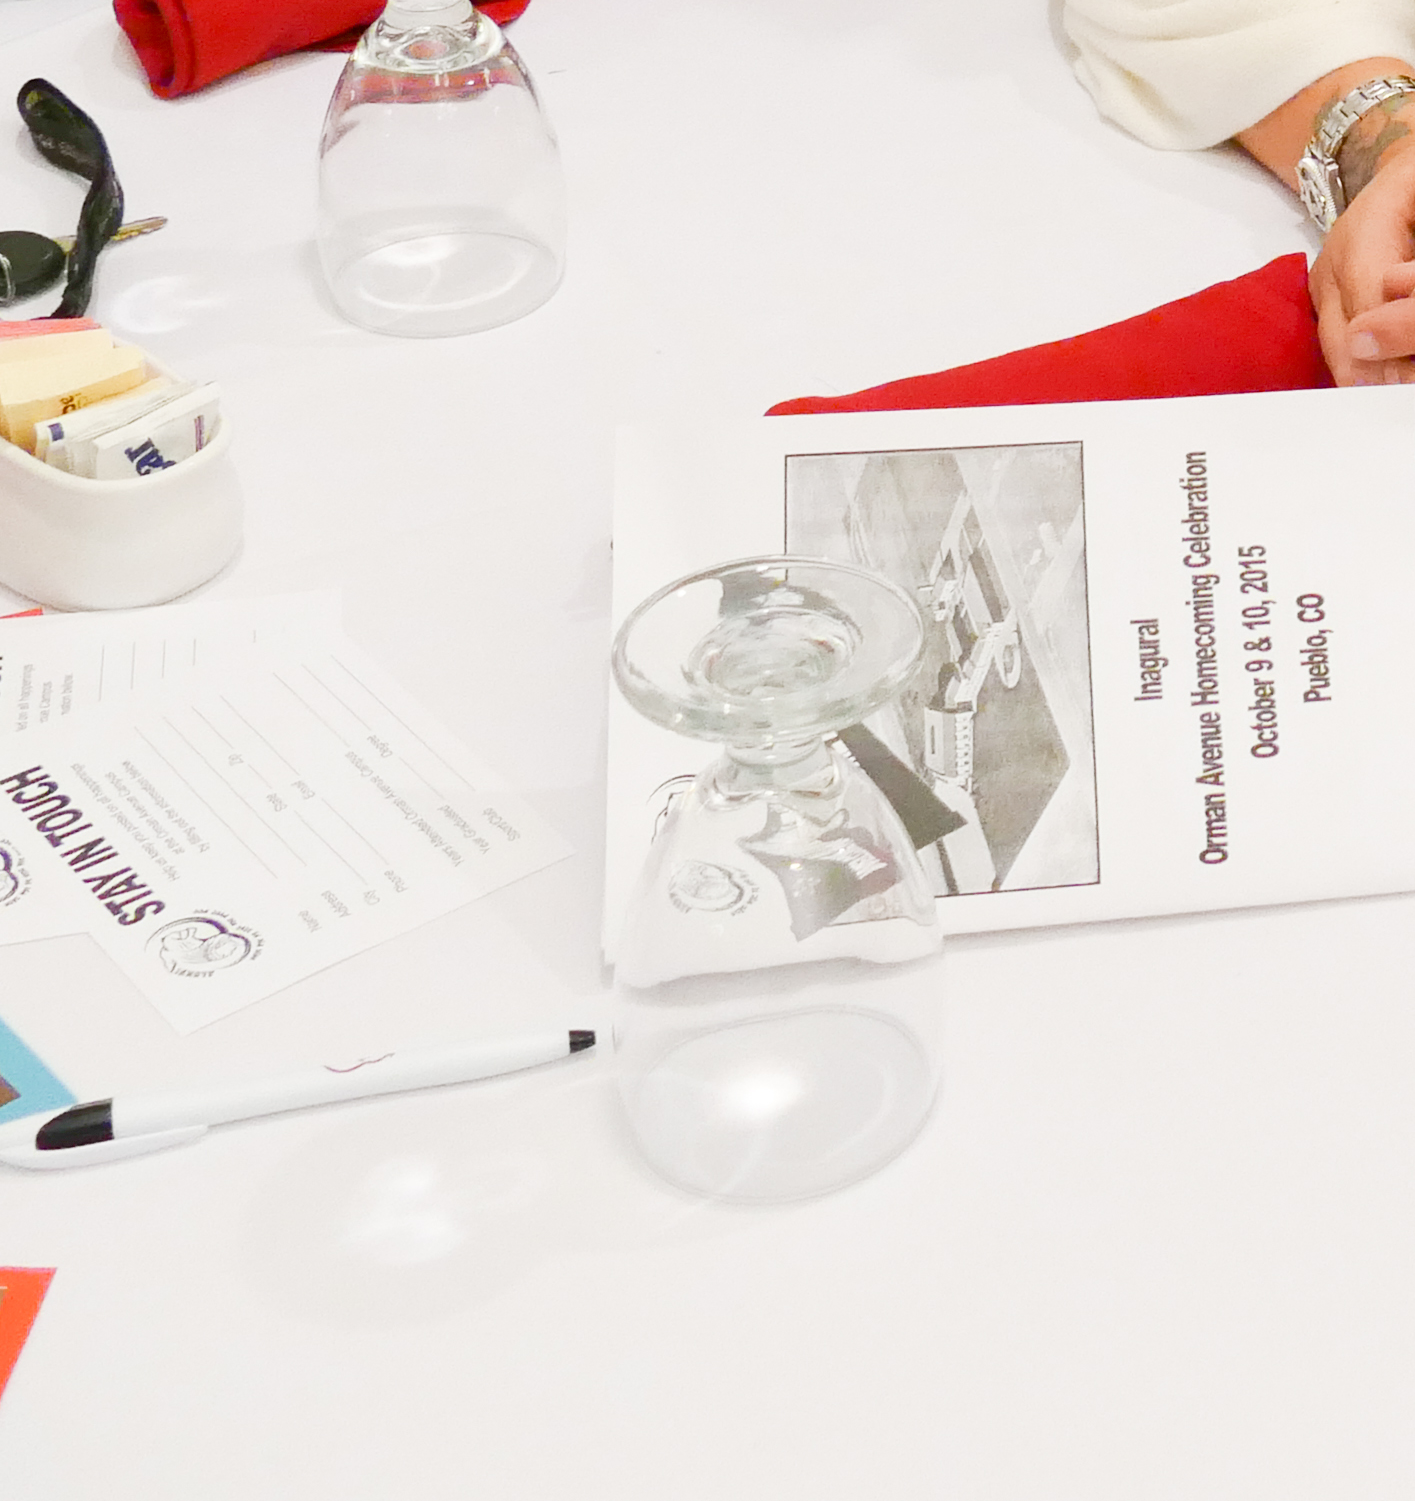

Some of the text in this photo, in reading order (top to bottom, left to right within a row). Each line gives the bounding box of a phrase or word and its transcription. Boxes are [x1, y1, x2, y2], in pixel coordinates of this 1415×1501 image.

[1130, 617, 1169, 702] Inagural
[1178, 450, 1229, 866] Orman Avenue Homecoming Celebration
[1237, 544, 1280, 759] October 9 & 10, 2015
[1295, 592, 1334, 703] Pueblo, CO
[227, 753, 245, 767] Zip
[366, 734, 394, 759] Degree
[344, 751, 374, 778] Campus
[370, 775, 396, 799] Avenue
[265, 792, 288, 813] State
[411, 817, 448, 848] Attended
[436, 804, 491, 855] Year Graduated
[0, 764, 166, 927] STAY IN TOUCH
[441, 845, 465, 868] Years
[383, 869, 409, 893] Phone
[320, 889, 352, 919] Address
[362, 889, 381, 906] City
[297, 909, 323, 934] Name
